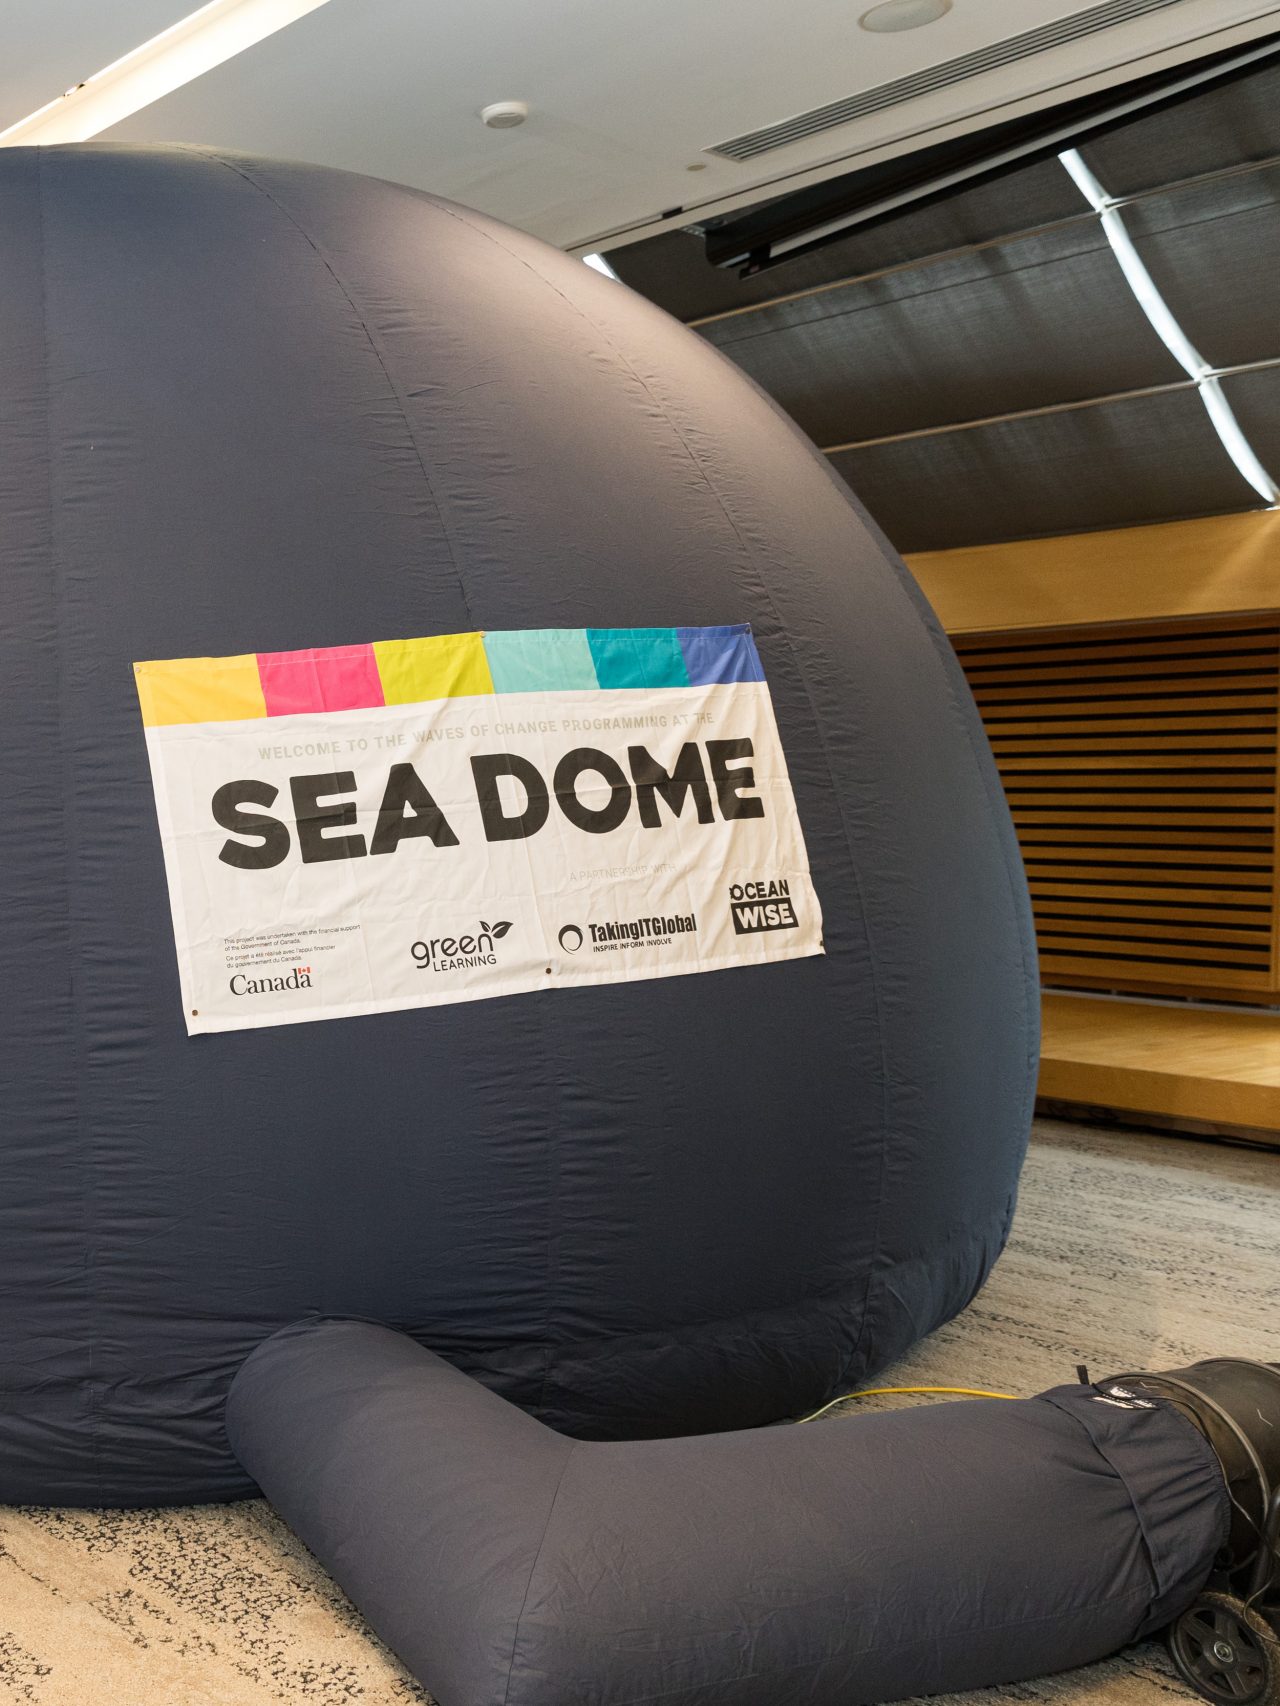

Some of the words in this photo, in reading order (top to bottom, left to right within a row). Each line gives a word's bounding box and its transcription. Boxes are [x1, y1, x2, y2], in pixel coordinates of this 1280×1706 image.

[258, 741, 341, 760] WELCOME
[346, 738, 368, 752] TO
[374, 734, 407, 749] THE
[412, 726, 465, 744] WAVES
[470, 724, 489, 737] OF
[494, 720, 557, 736] CHANGE
[562, 715, 668, 732] PROGRAMMING
[672, 713, 689, 727] AT
[693, 712, 714, 724] THE
[211, 762, 460, 870] SEA
[470, 737, 764, 844] DOME
[729, 879, 790, 901] OCEAN
[588, 913, 697, 942] TakingITGlobal
[735, 903, 794, 929] WISE
[236, 936, 254, 944] project
[267, 932, 297, 940] undertaken
[319, 927, 339, 935] financial
[340, 924, 361, 933] support
[241, 941, 272, 950] Government
[593, 943, 618, 952] INSPIRE
[619, 940, 644, 950] INFORM
[646, 937, 672, 946] INVOLVE
[235, 954, 250, 962] projet
[314, 944, 336, 952] financier
[411, 933, 494, 969] green
[433, 954, 497, 972] LEARNING
[229, 967, 313, 996] Canada
